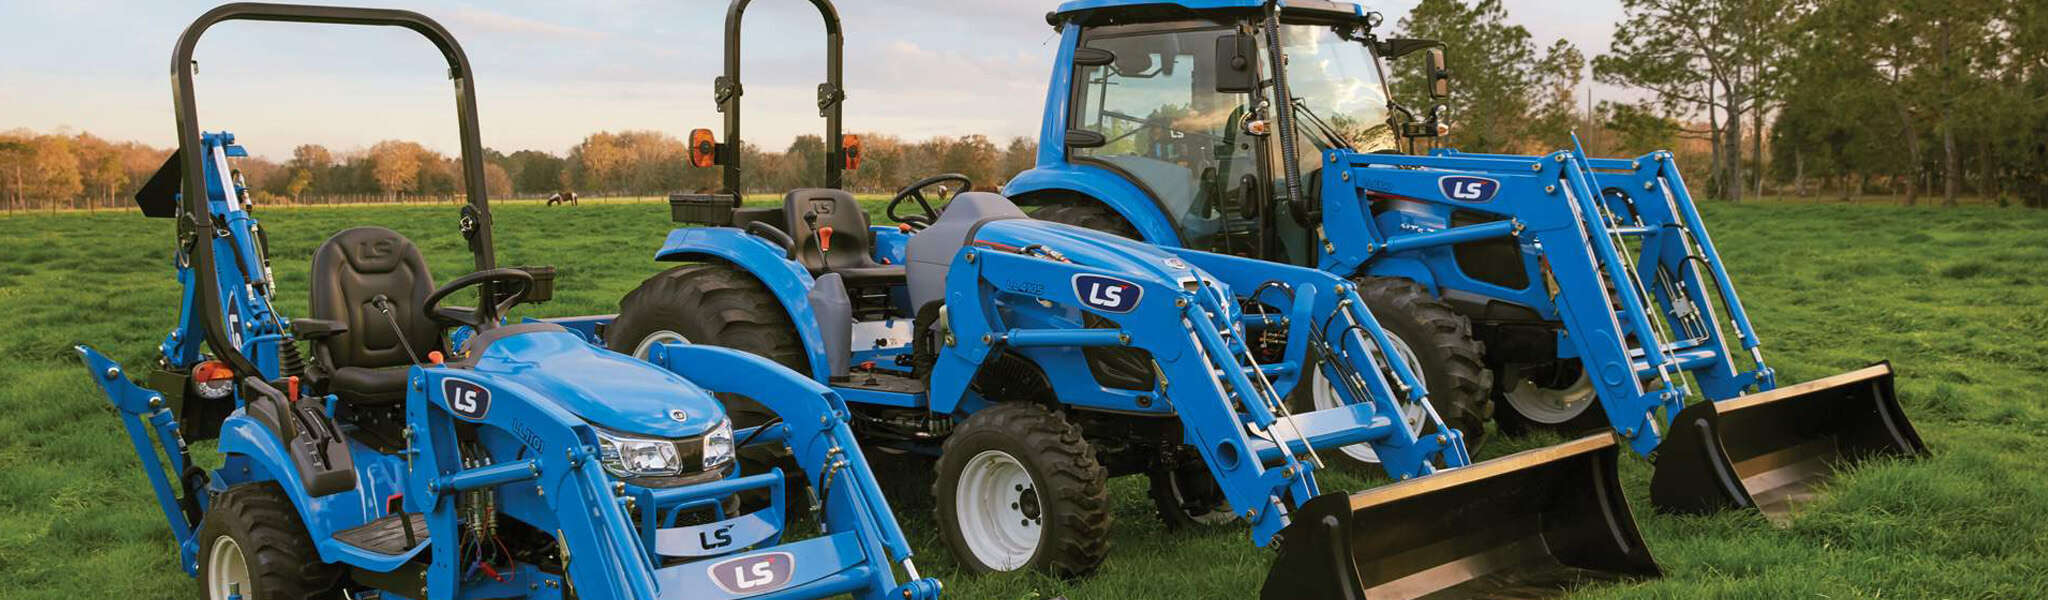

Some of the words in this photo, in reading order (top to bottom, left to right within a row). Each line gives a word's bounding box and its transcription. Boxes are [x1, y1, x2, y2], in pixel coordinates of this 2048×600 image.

[1453, 181, 1484, 200] LS
[357, 240, 393, 263] LS
[1089, 282, 1124, 308] LS
[454, 386, 478, 414] LS
[699, 526, 734, 551] LS
[734, 559, 774, 590] LS
